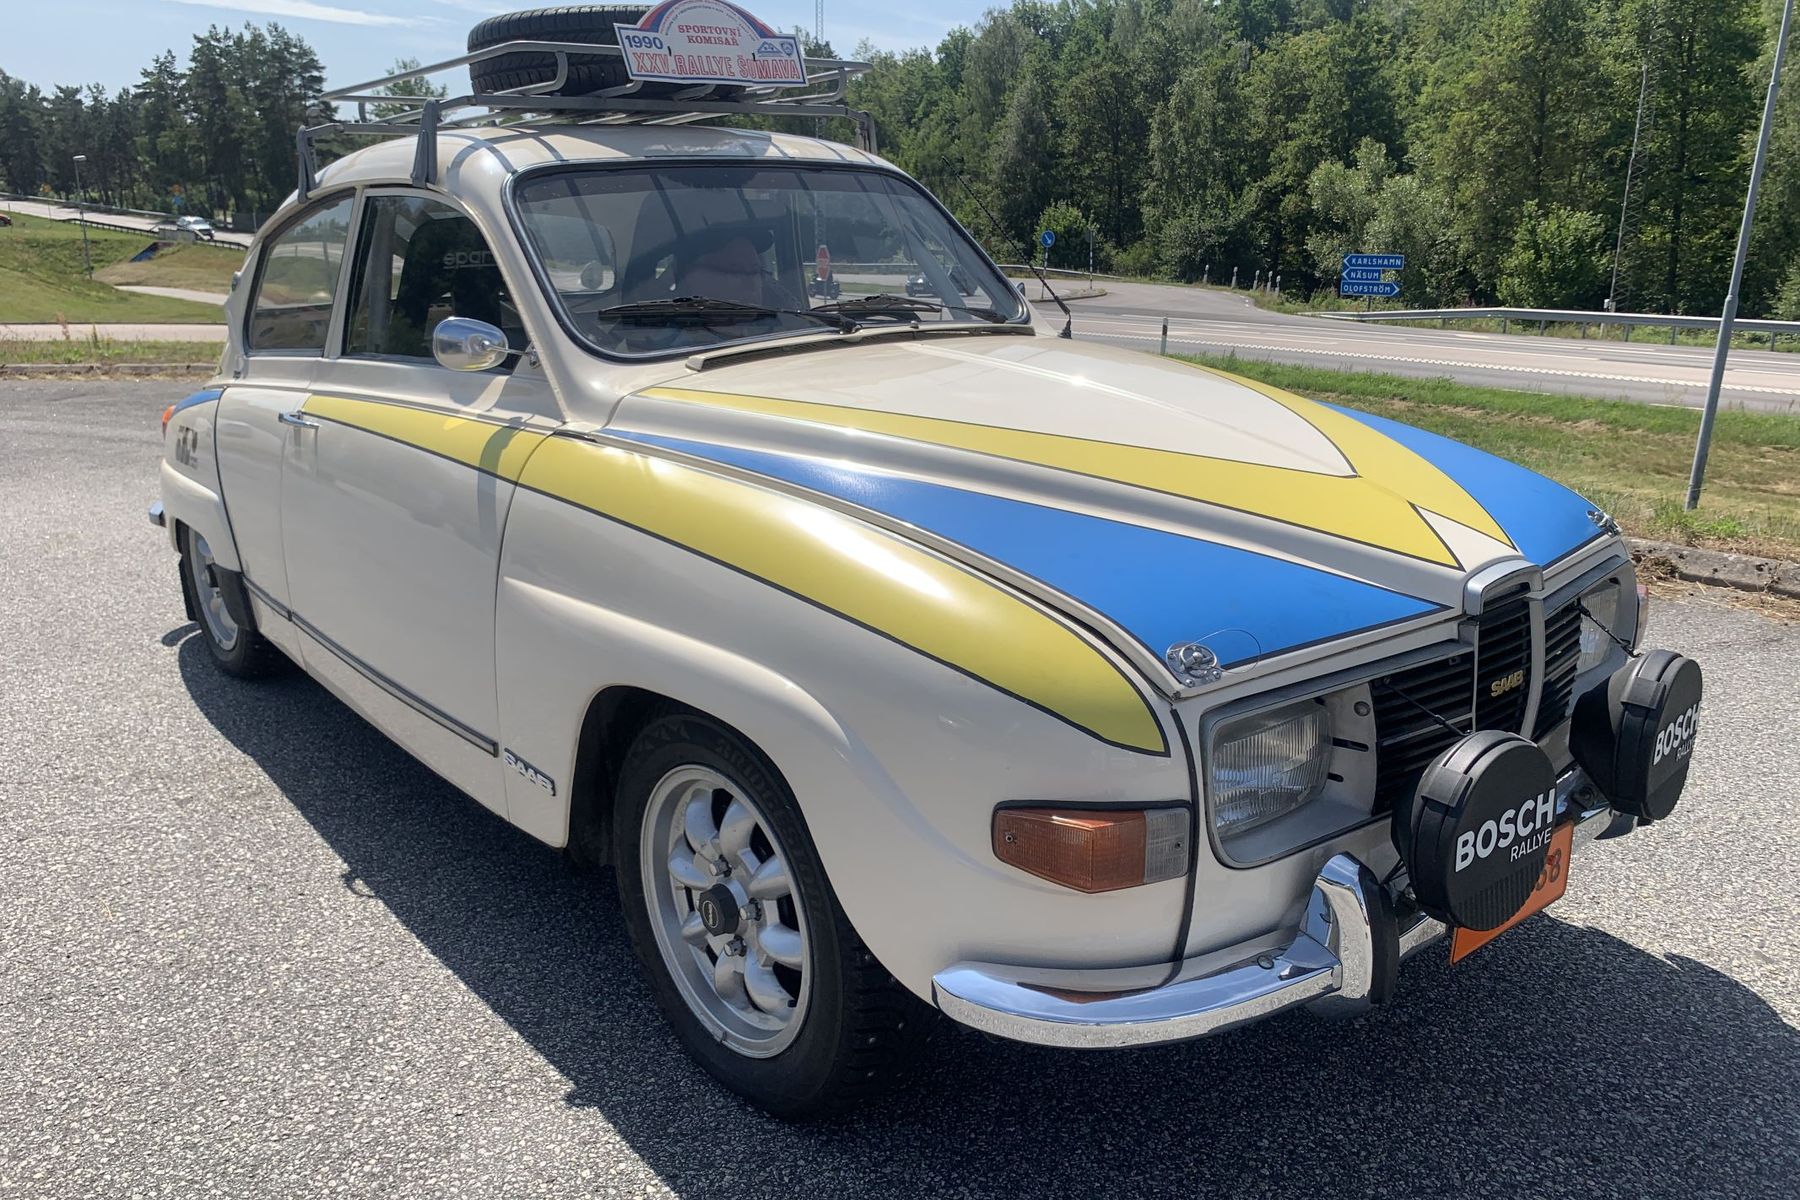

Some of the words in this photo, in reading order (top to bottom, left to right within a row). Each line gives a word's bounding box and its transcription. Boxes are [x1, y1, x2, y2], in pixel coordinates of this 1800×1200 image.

[625, 35, 663, 49] 1990
[674, 54, 736, 76] RALLYE
[1351, 257, 1401, 266] KARLSHAMN
[1350, 270, 1379, 279] NÄSUM
[1343, 284, 1391, 293] OLOFSTRÖM
[1491, 670, 1524, 697] SAAB
[1653, 701, 1701, 767] BOSCH
[1455, 787, 1556, 873] BOSCH
[1510, 827, 1552, 863] RALLYE
